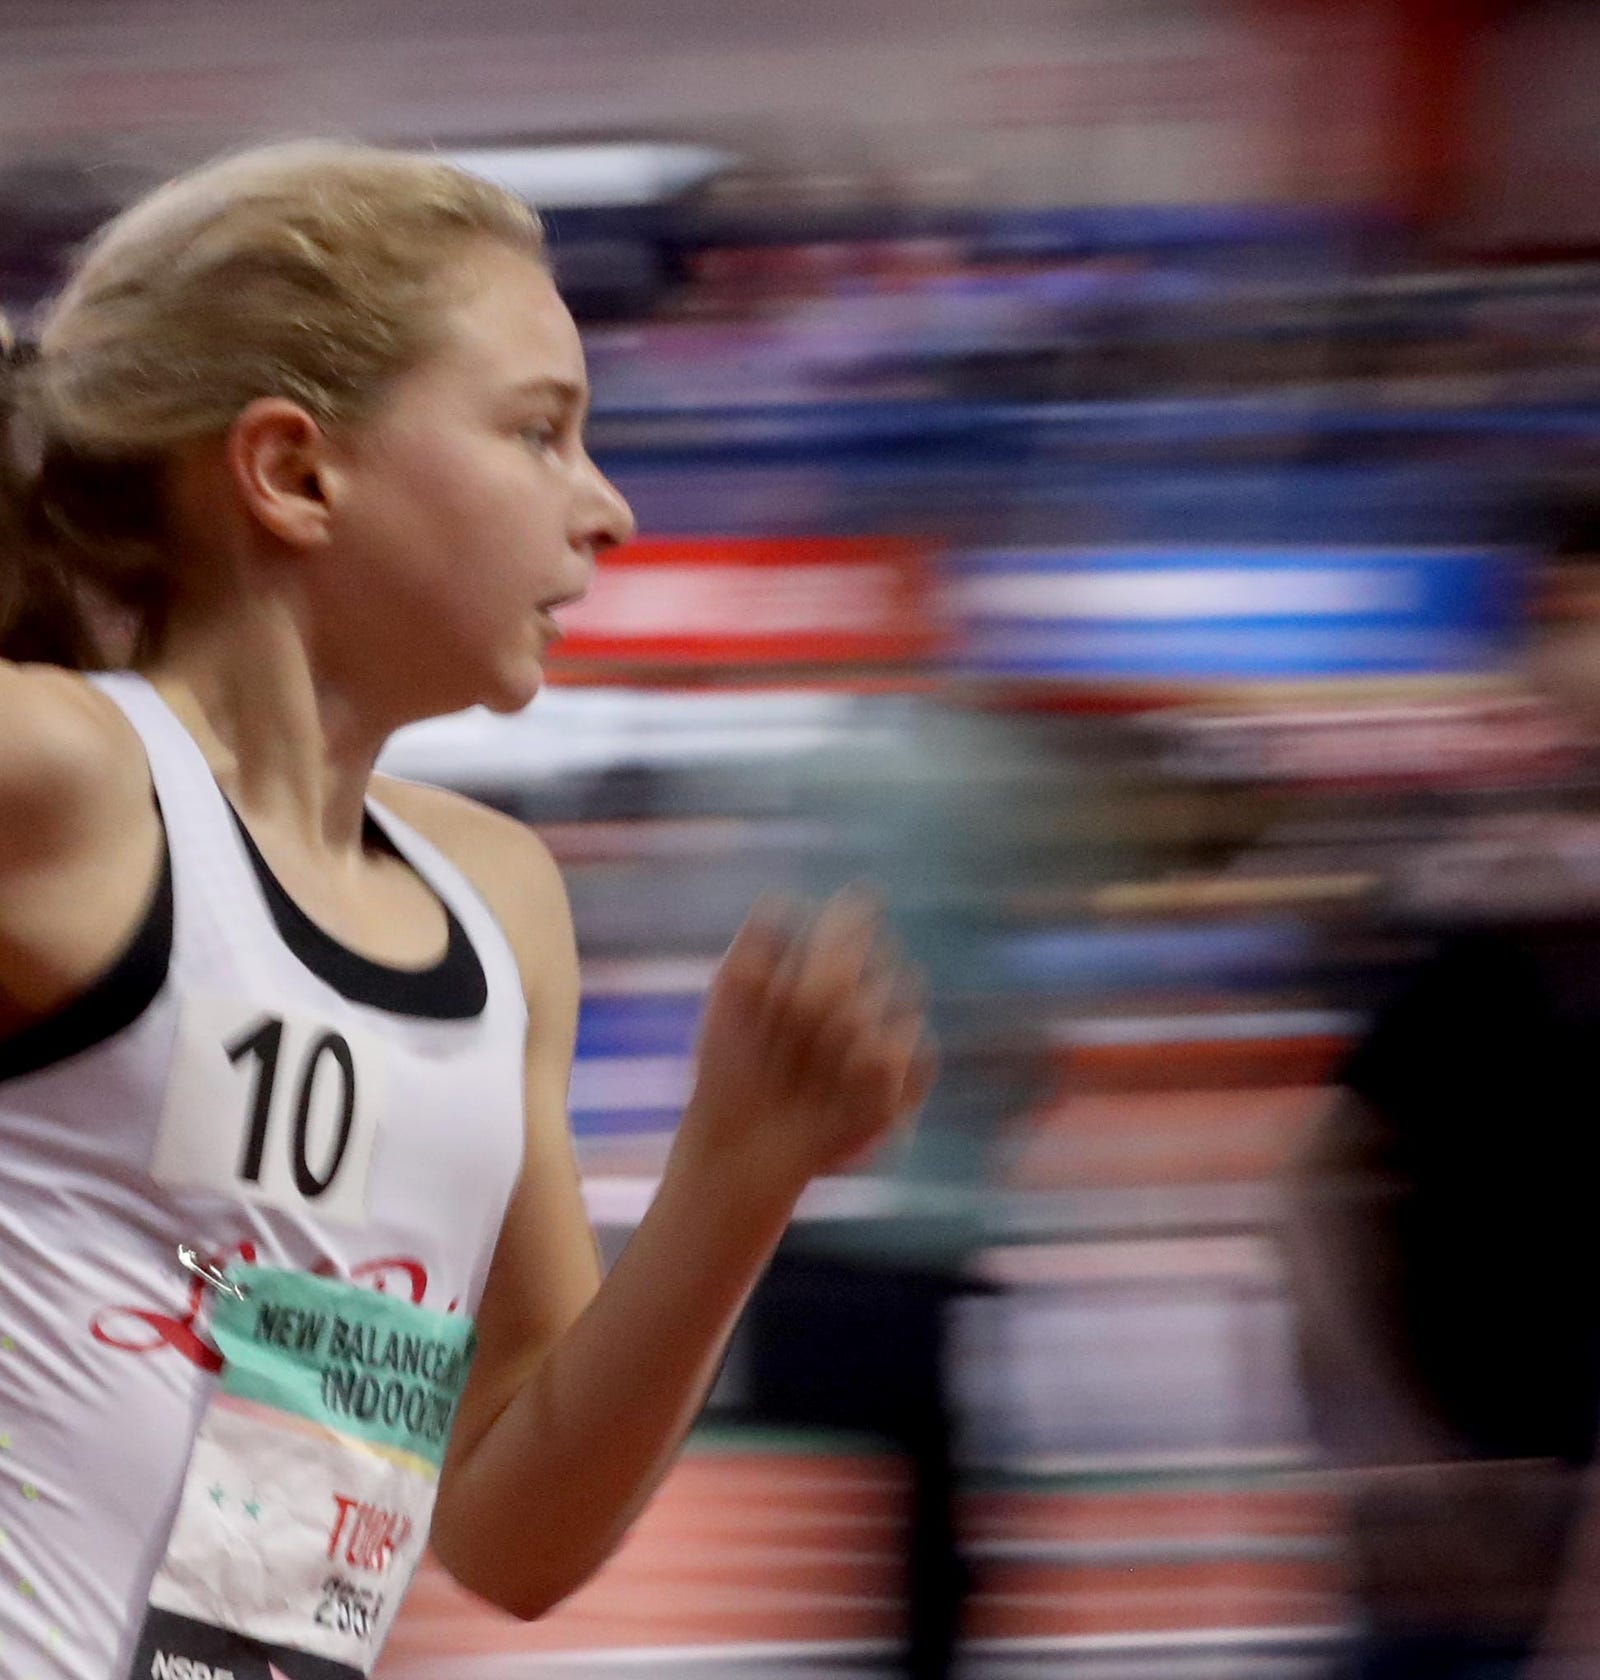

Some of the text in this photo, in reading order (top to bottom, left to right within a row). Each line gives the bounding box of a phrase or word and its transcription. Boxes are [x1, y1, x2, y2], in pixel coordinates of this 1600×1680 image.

[222, 1014, 355, 1197] 10
[255, 1302, 326, 1352] NEW
[327, 1312, 448, 1385] BALANCE
